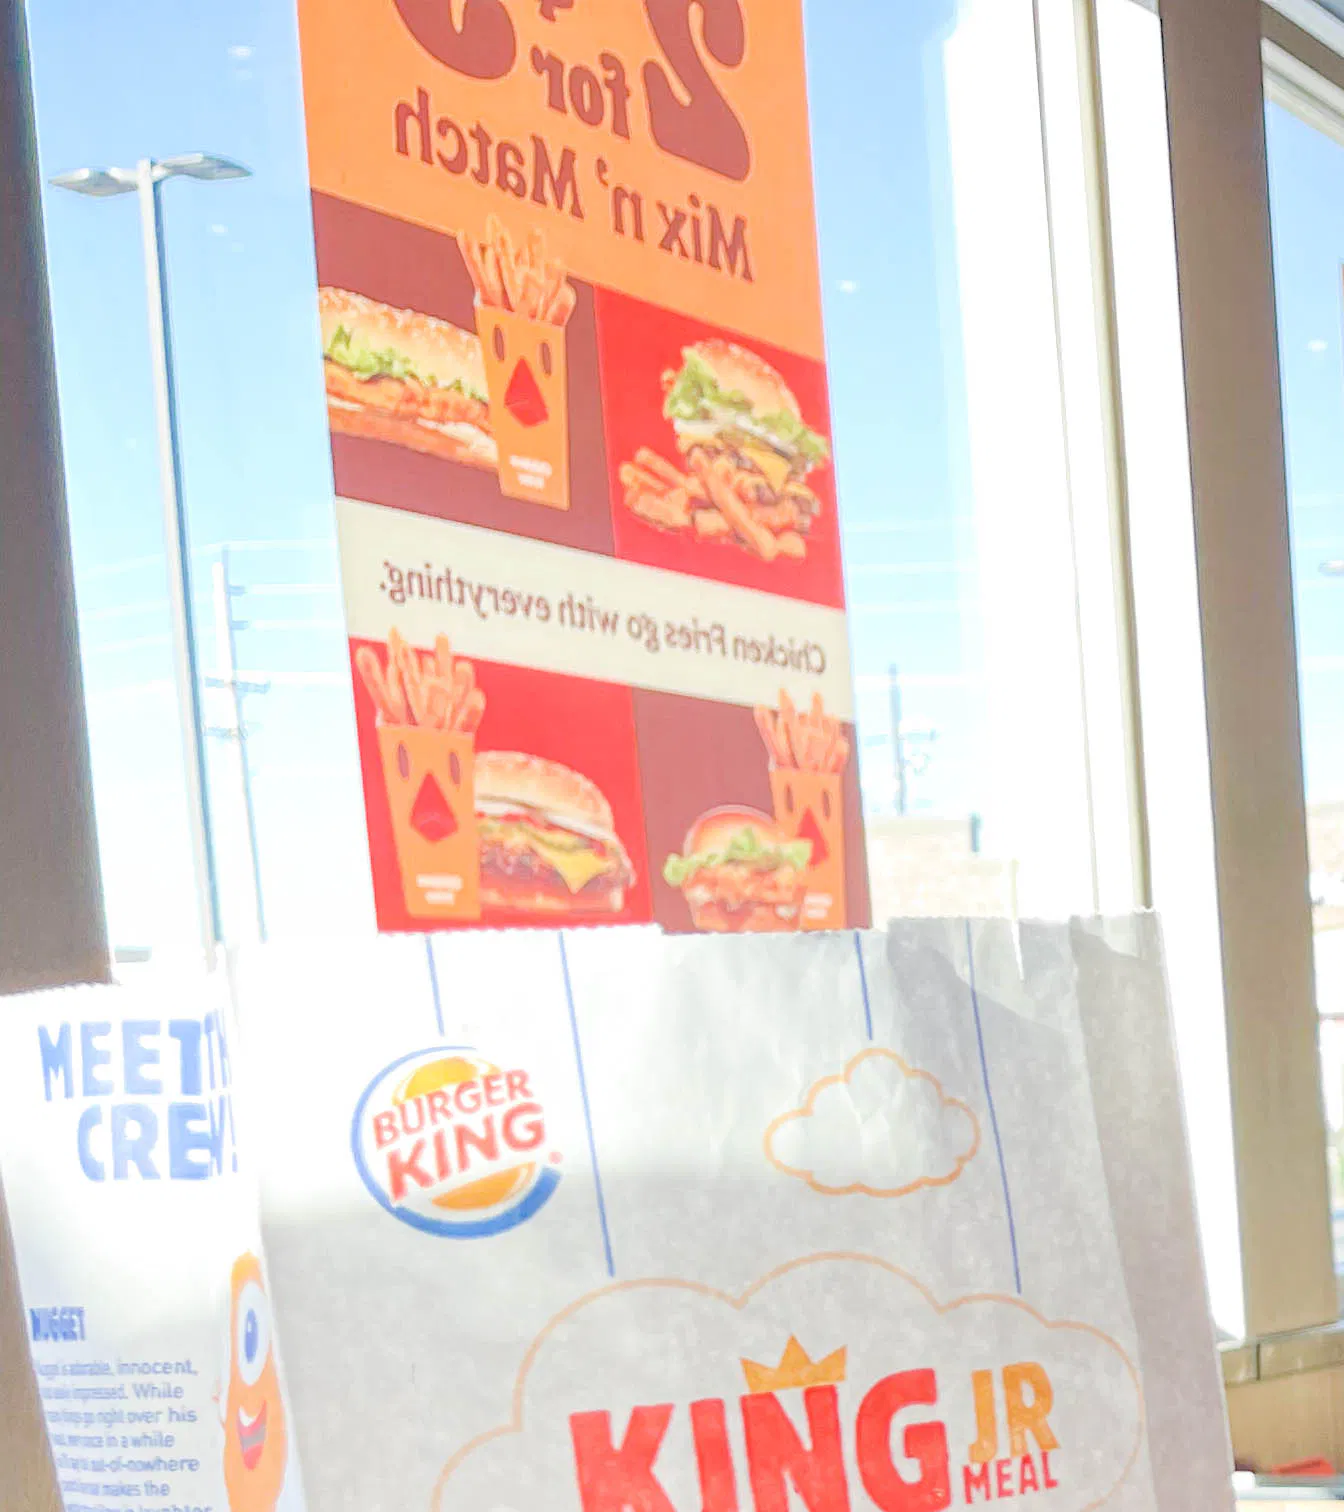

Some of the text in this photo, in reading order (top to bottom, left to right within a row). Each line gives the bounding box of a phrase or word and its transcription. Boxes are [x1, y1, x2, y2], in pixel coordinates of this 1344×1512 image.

[36, 1018, 203, 1103] MEET
[372, 1067, 534, 1150] BURGER
[385, 1101, 548, 1203] KING
[131, 1382, 186, 1400] While
[167, 1406, 199, 1424] his
[966, 1360, 1061, 1466] JR
[962, 1448, 1059, 1505] MEAL
